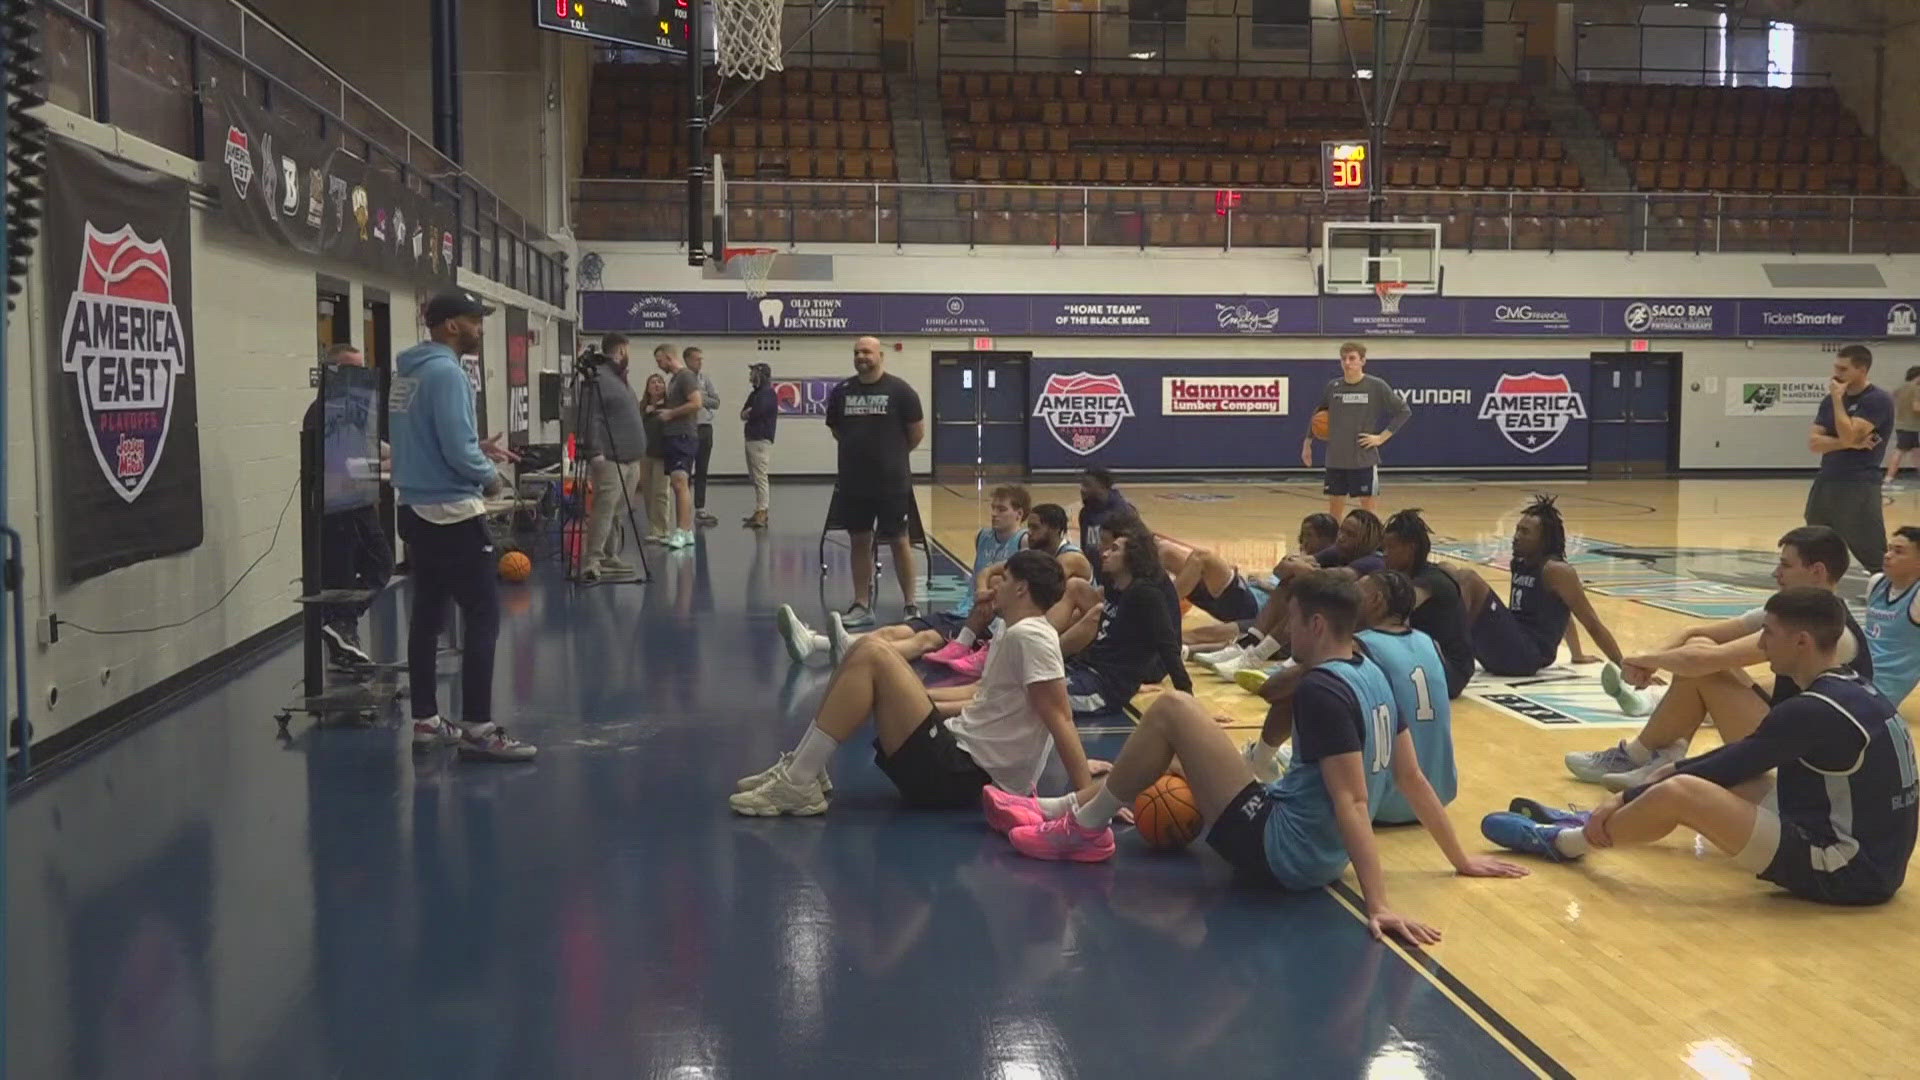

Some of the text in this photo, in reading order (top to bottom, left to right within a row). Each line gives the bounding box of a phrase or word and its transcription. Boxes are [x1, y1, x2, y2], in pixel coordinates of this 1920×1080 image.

[574, 3, 584, 17] 4
[660, 21, 669, 34] 4
[1333, 161, 1361, 186] 30
[790, 299, 842, 308] OLD TOWN
[1652, 305, 1712, 316] SACO BAY
[798, 308, 834, 317] FAMILY
[1495, 305, 1532, 319] CMG
[1762, 313, 1844, 325] TicketSmarter
[784, 318, 848, 328] DENTISTRY
[1056, 316, 1150, 324] OF THE BLACK BEARS
[65, 300, 183, 368] AMERICA
[100, 356, 159, 402] EAST
[1171, 380, 1280, 397] Hammond
[1782, 383, 1825, 391] RENEWAL
[1039, 396, 1130, 413] AMERICA
[1174, 401, 1277, 412] Lumber Company
[1484, 396, 1581, 415] AMERICA
[1058, 411, 1108, 424] EAST
[1505, 413, 1559, 428] EAST
[1409, 665, 1435, 721] 1
[1372, 704, 1392, 774] 10
